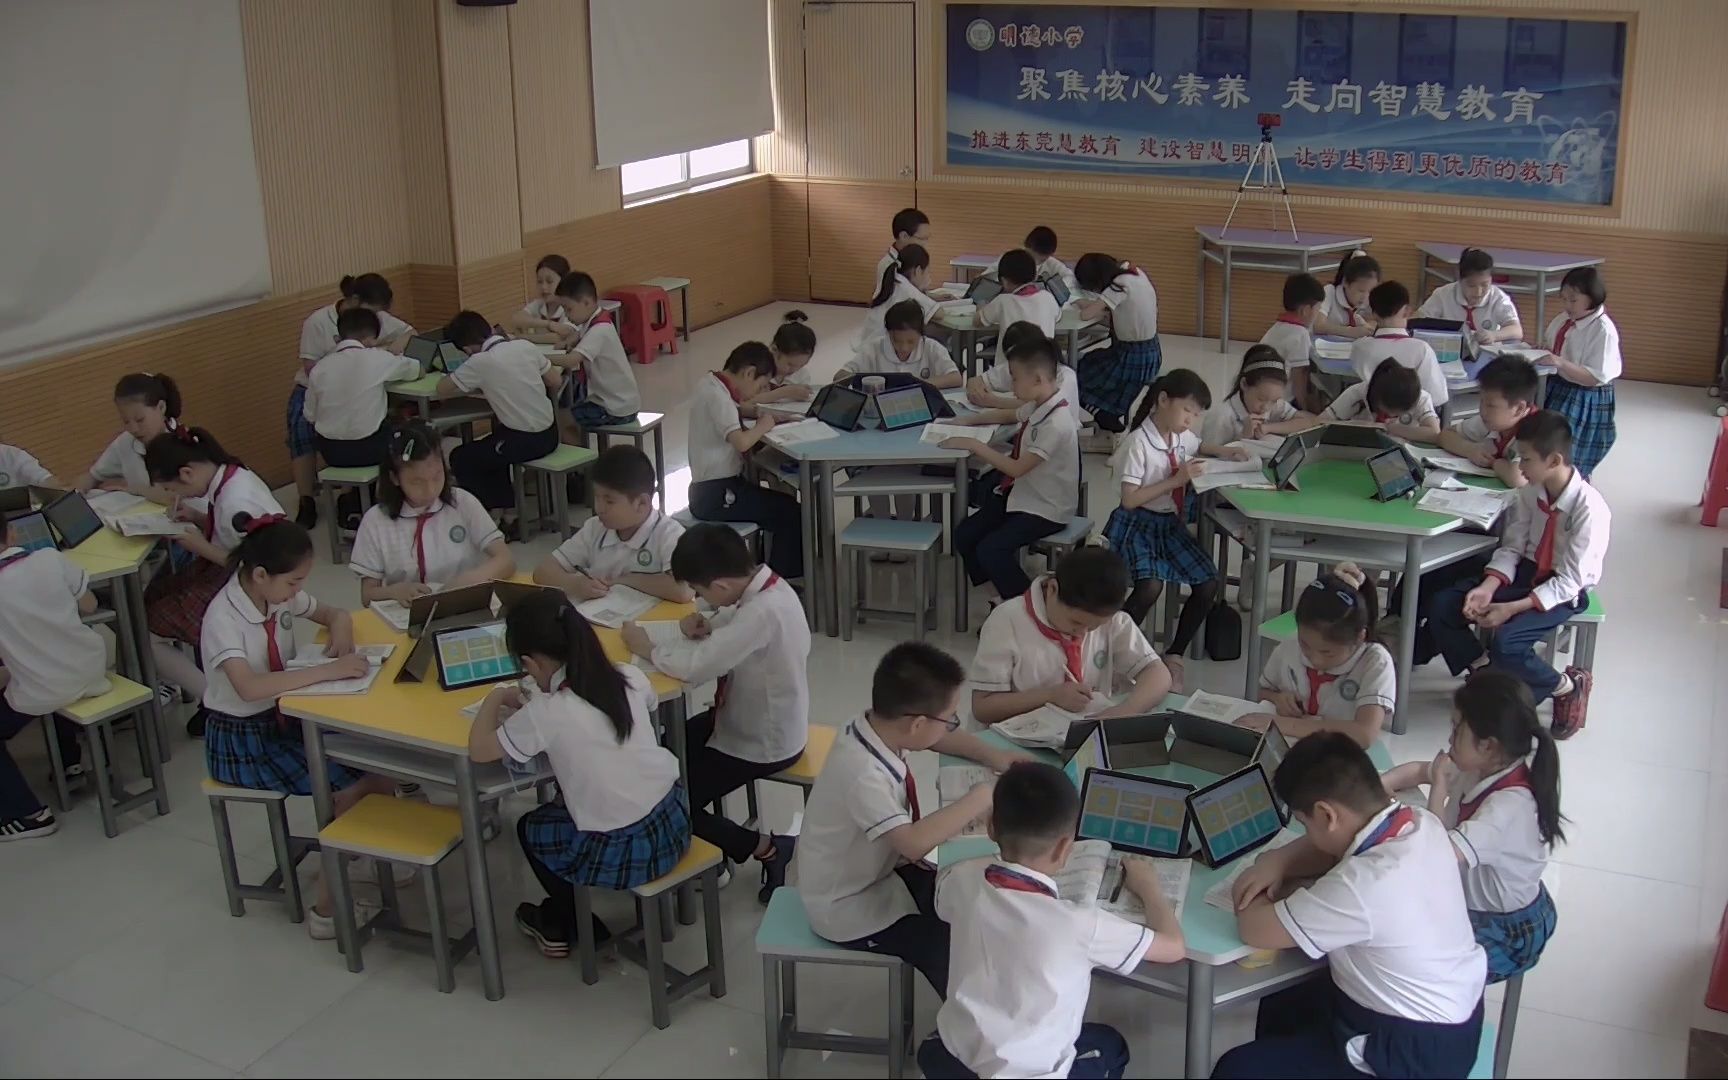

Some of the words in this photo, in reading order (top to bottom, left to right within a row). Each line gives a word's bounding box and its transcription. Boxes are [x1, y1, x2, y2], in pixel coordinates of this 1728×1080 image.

[998, 23, 1085, 49] 明德小学
[1016, 66, 1251, 109] 聚焦核心素养
[1281, 76, 1544, 125] 走向智慧教育
[971, 129, 1121, 156] 推进东莞慧教育
[1295, 145, 1569, 185] 让学生得到更优质的教育
